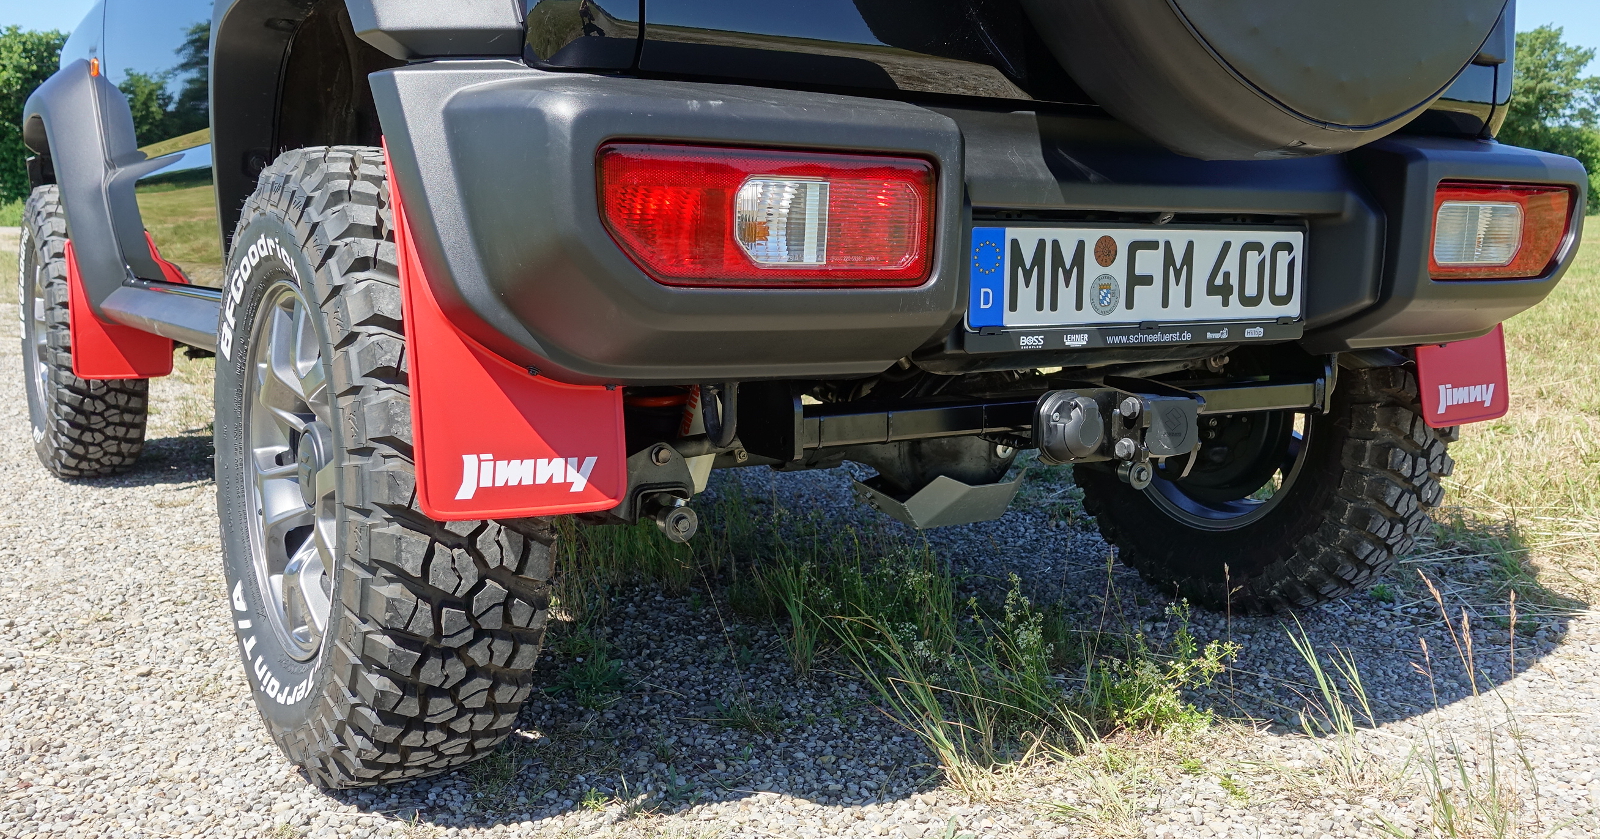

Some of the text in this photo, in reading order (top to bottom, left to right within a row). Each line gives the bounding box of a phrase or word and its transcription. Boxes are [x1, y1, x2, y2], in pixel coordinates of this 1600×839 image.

[1009, 238, 1296, 313] MM FM 400
[220, 233, 302, 362] BFGoodrich
[980, 287, 993, 309] D
[1019, 335, 1045, 346] BOSS
[1063, 333, 1089, 342] LEHNER
[1106, 330, 1192, 344] www.schneefuerst.de
[1437, 383, 1495, 414] Jimny
[454, 453, 598, 500] Jimny
